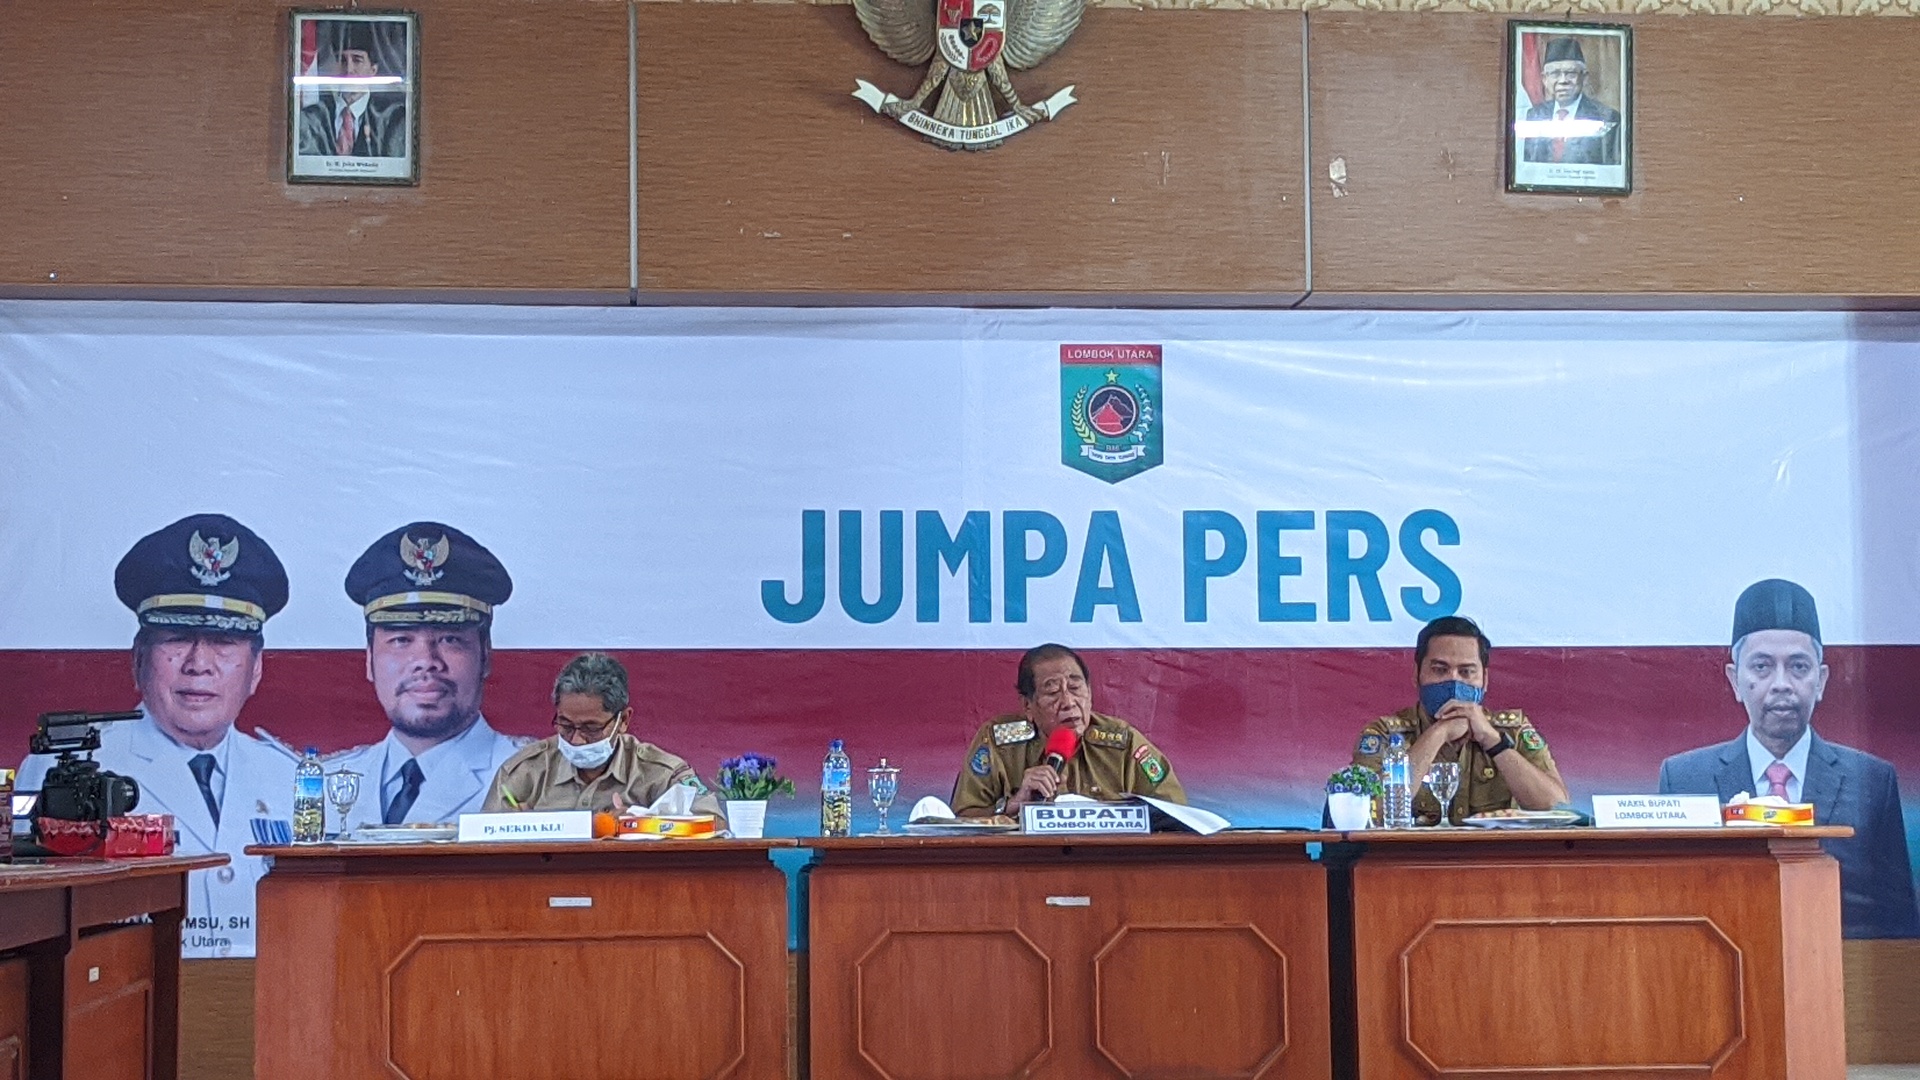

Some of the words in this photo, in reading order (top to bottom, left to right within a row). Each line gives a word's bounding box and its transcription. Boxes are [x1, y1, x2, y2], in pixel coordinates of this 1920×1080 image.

[908, 112, 955, 139] BHINNEKA
[960, 127, 1004, 140] TUNGGAL
[1006, 116, 1023, 132] IKA
[1067, 349, 1114, 359] LOMBOK
[1117, 349, 1154, 359] UTARA
[761, 510, 1142, 623] JUMPA
[1182, 509, 1462, 623] PERS
[1648, 799, 1681, 807] BUPATI
[1036, 808, 1143, 820] BUPATI
[1615, 811, 1654, 820] LOMBOK
[1656, 811, 1687, 819] UTARA
[541, 823, 565, 832] KLU
[1038, 821, 1096, 829] LOMBOK
[1099, 821, 1143, 829] UTARA
[229, 916, 250, 929] SH
[191, 935, 229, 947] Utara
